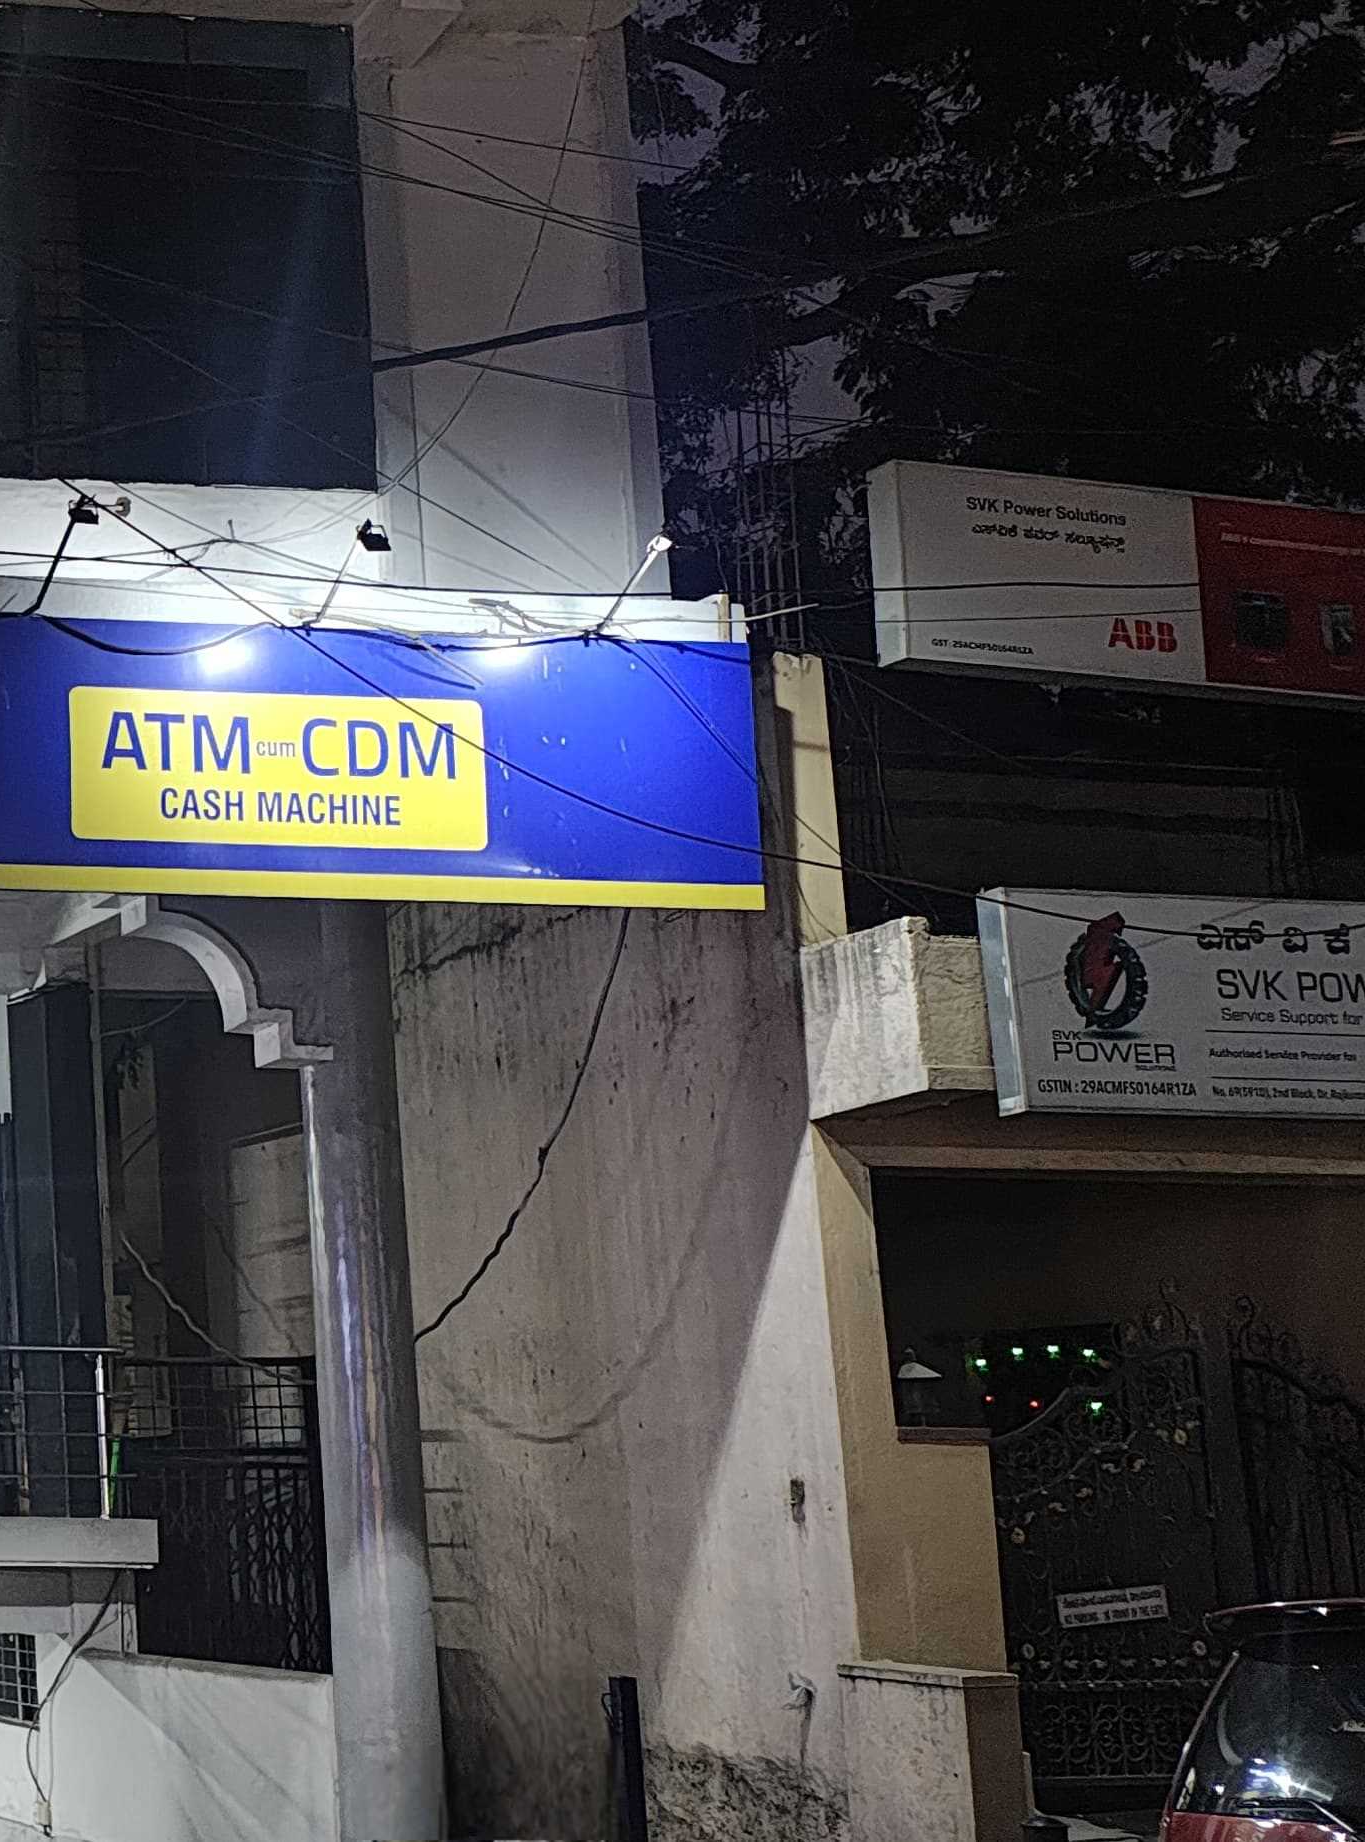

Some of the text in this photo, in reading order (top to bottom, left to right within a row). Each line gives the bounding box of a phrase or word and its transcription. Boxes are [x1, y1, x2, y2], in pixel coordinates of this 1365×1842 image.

[966, 496, 1127, 526] SVK Power Solutions
[1108, 617, 1178, 653] ABB
[102, 711, 457, 779] ATM cum CDM
[161, 788, 401, 826] CASH MACHINE
[1216, 968, 1287, 1002] SVK
[1221, 1007, 1363, 1027] Service Support for
[1052, 1030, 1081, 1040] SVK
[1053, 1041, 1175, 1064] POWER
